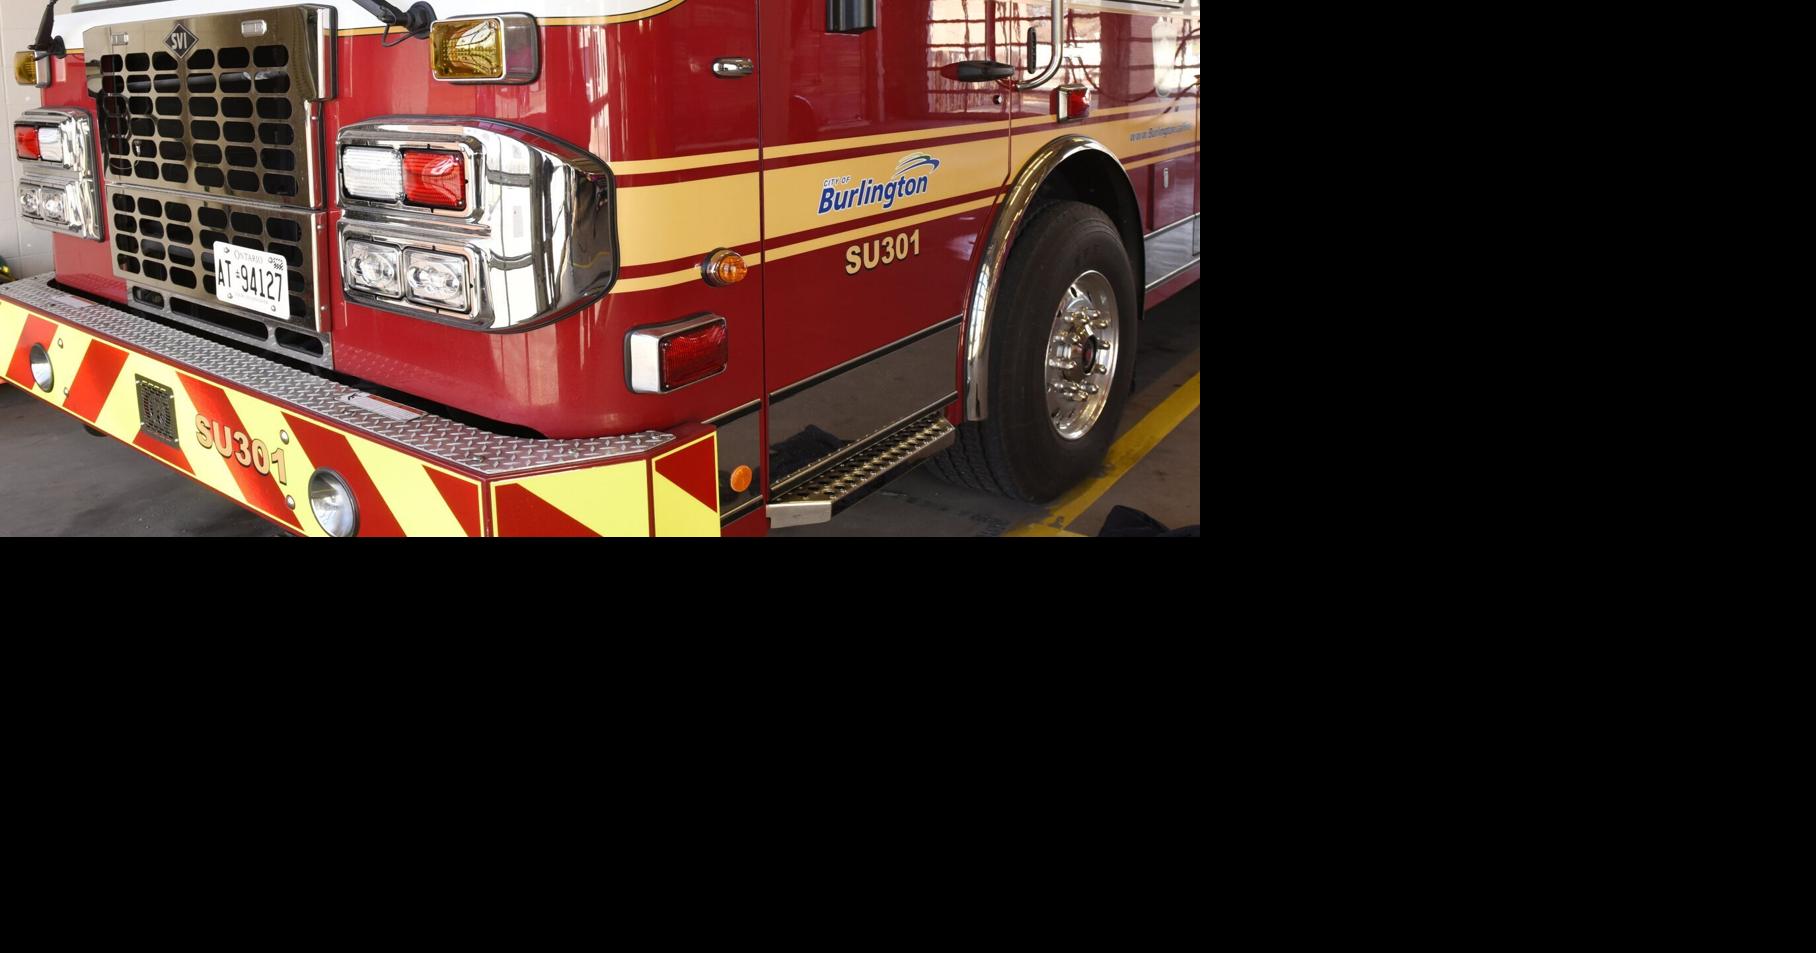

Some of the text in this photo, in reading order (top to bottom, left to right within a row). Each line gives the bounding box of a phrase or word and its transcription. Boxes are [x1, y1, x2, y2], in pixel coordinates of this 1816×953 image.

[171, 32, 187, 49] SVI
[818, 175, 928, 214] Burlington
[823, 176, 851, 187] CITY OF
[845, 228, 920, 275] SU301
[218, 258, 231, 288] AT
[240, 264, 282, 302] 94127
[195, 413, 287, 486] SU301
